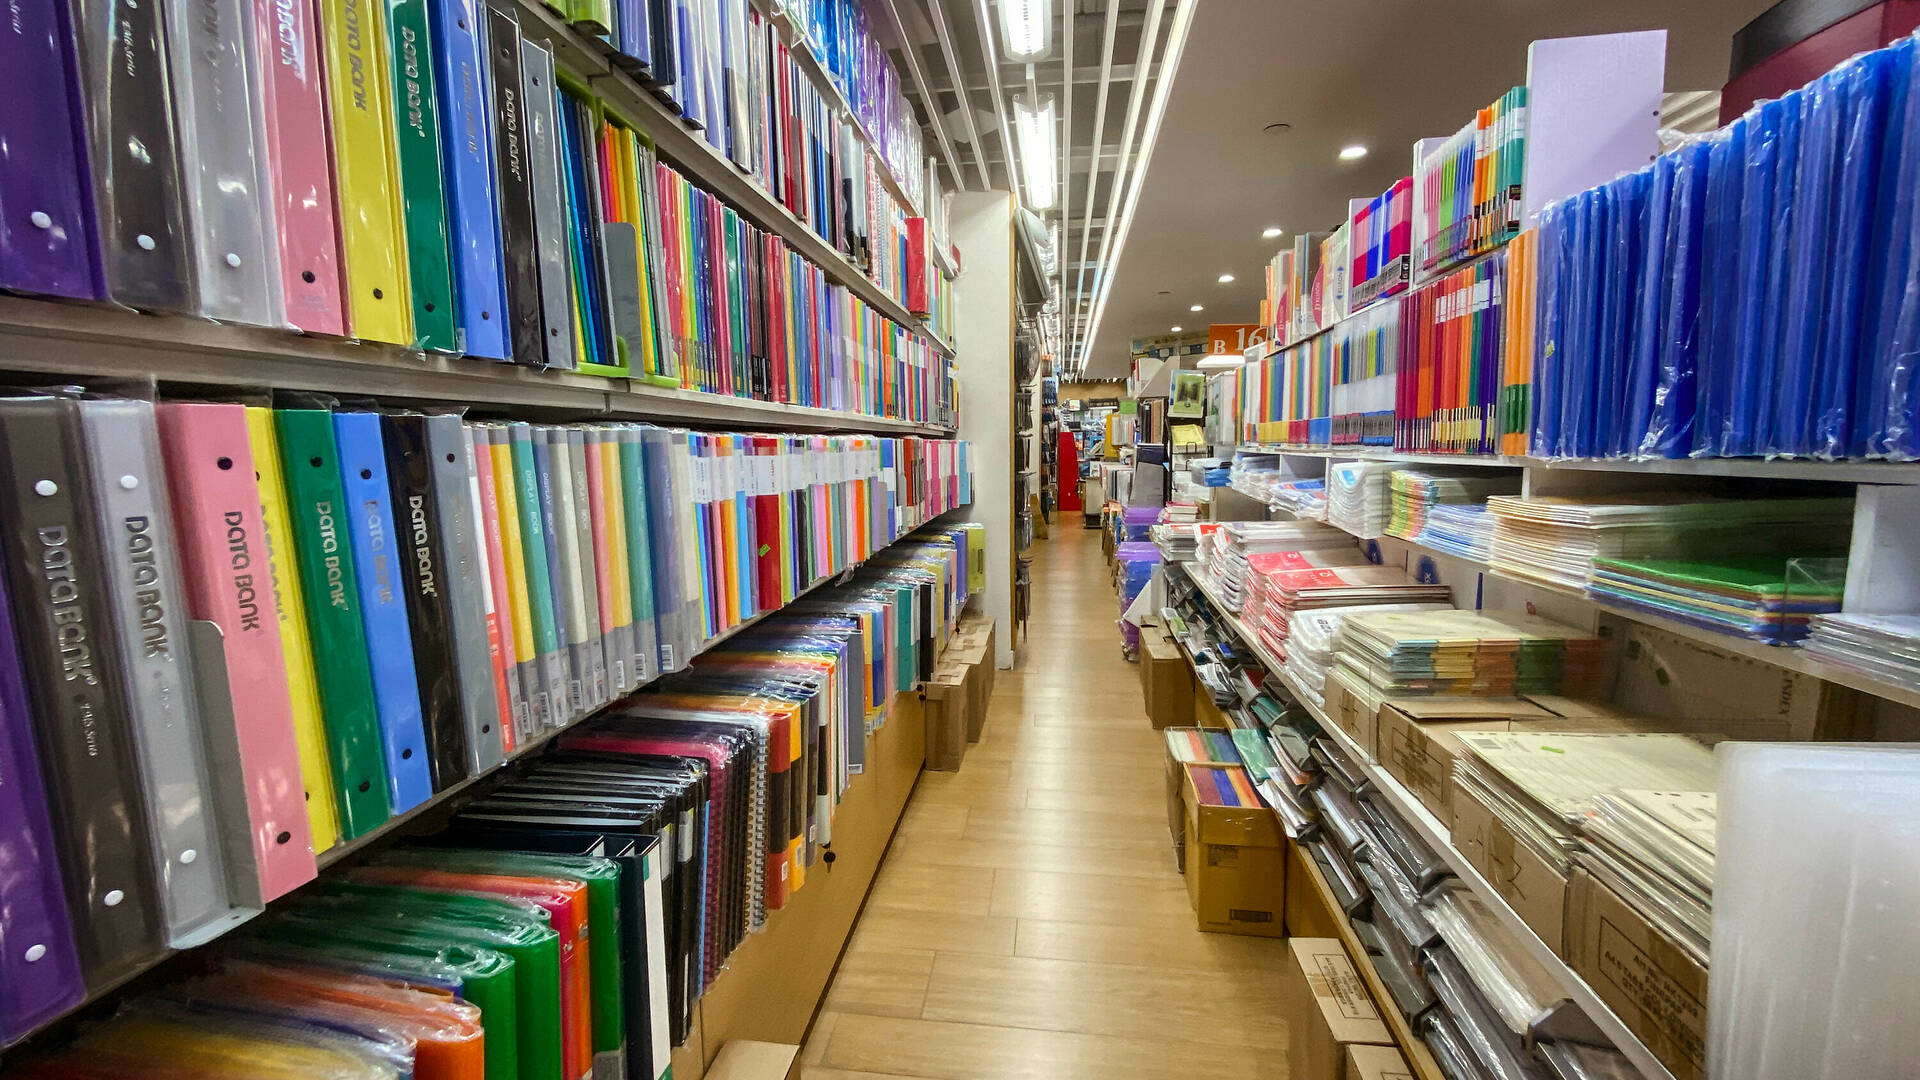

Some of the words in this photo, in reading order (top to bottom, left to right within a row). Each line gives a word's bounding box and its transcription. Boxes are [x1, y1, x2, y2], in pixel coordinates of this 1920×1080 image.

[402, 26, 419, 78] DATA
[349, 54, 367, 111] BANK
[406, 79, 423, 127] BANK
[504, 88, 517, 132] DATA
[508, 132, 520, 174] BANK
[1213, 339, 1226, 355] B
[1234, 327, 1268, 351] 16
[525, 470, 536, 504] DISPLAY
[542, 472, 552, 505] DISPLAY
[224, 511, 251, 570] DATA
[316, 501, 338, 554] DATA
[364, 499, 385, 552] DATA
[409, 495, 428, 545] DATA
[530, 511, 539, 535] BOOK
[38, 525, 79, 605] DATA
[125, 515, 160, 587] DATA
[416, 546, 435, 595] BANK
[234, 574, 261, 632] BANK
[324, 555, 346, 607] BANK
[54, 605, 92, 682] BANK
[135, 588, 169, 659] BANK
